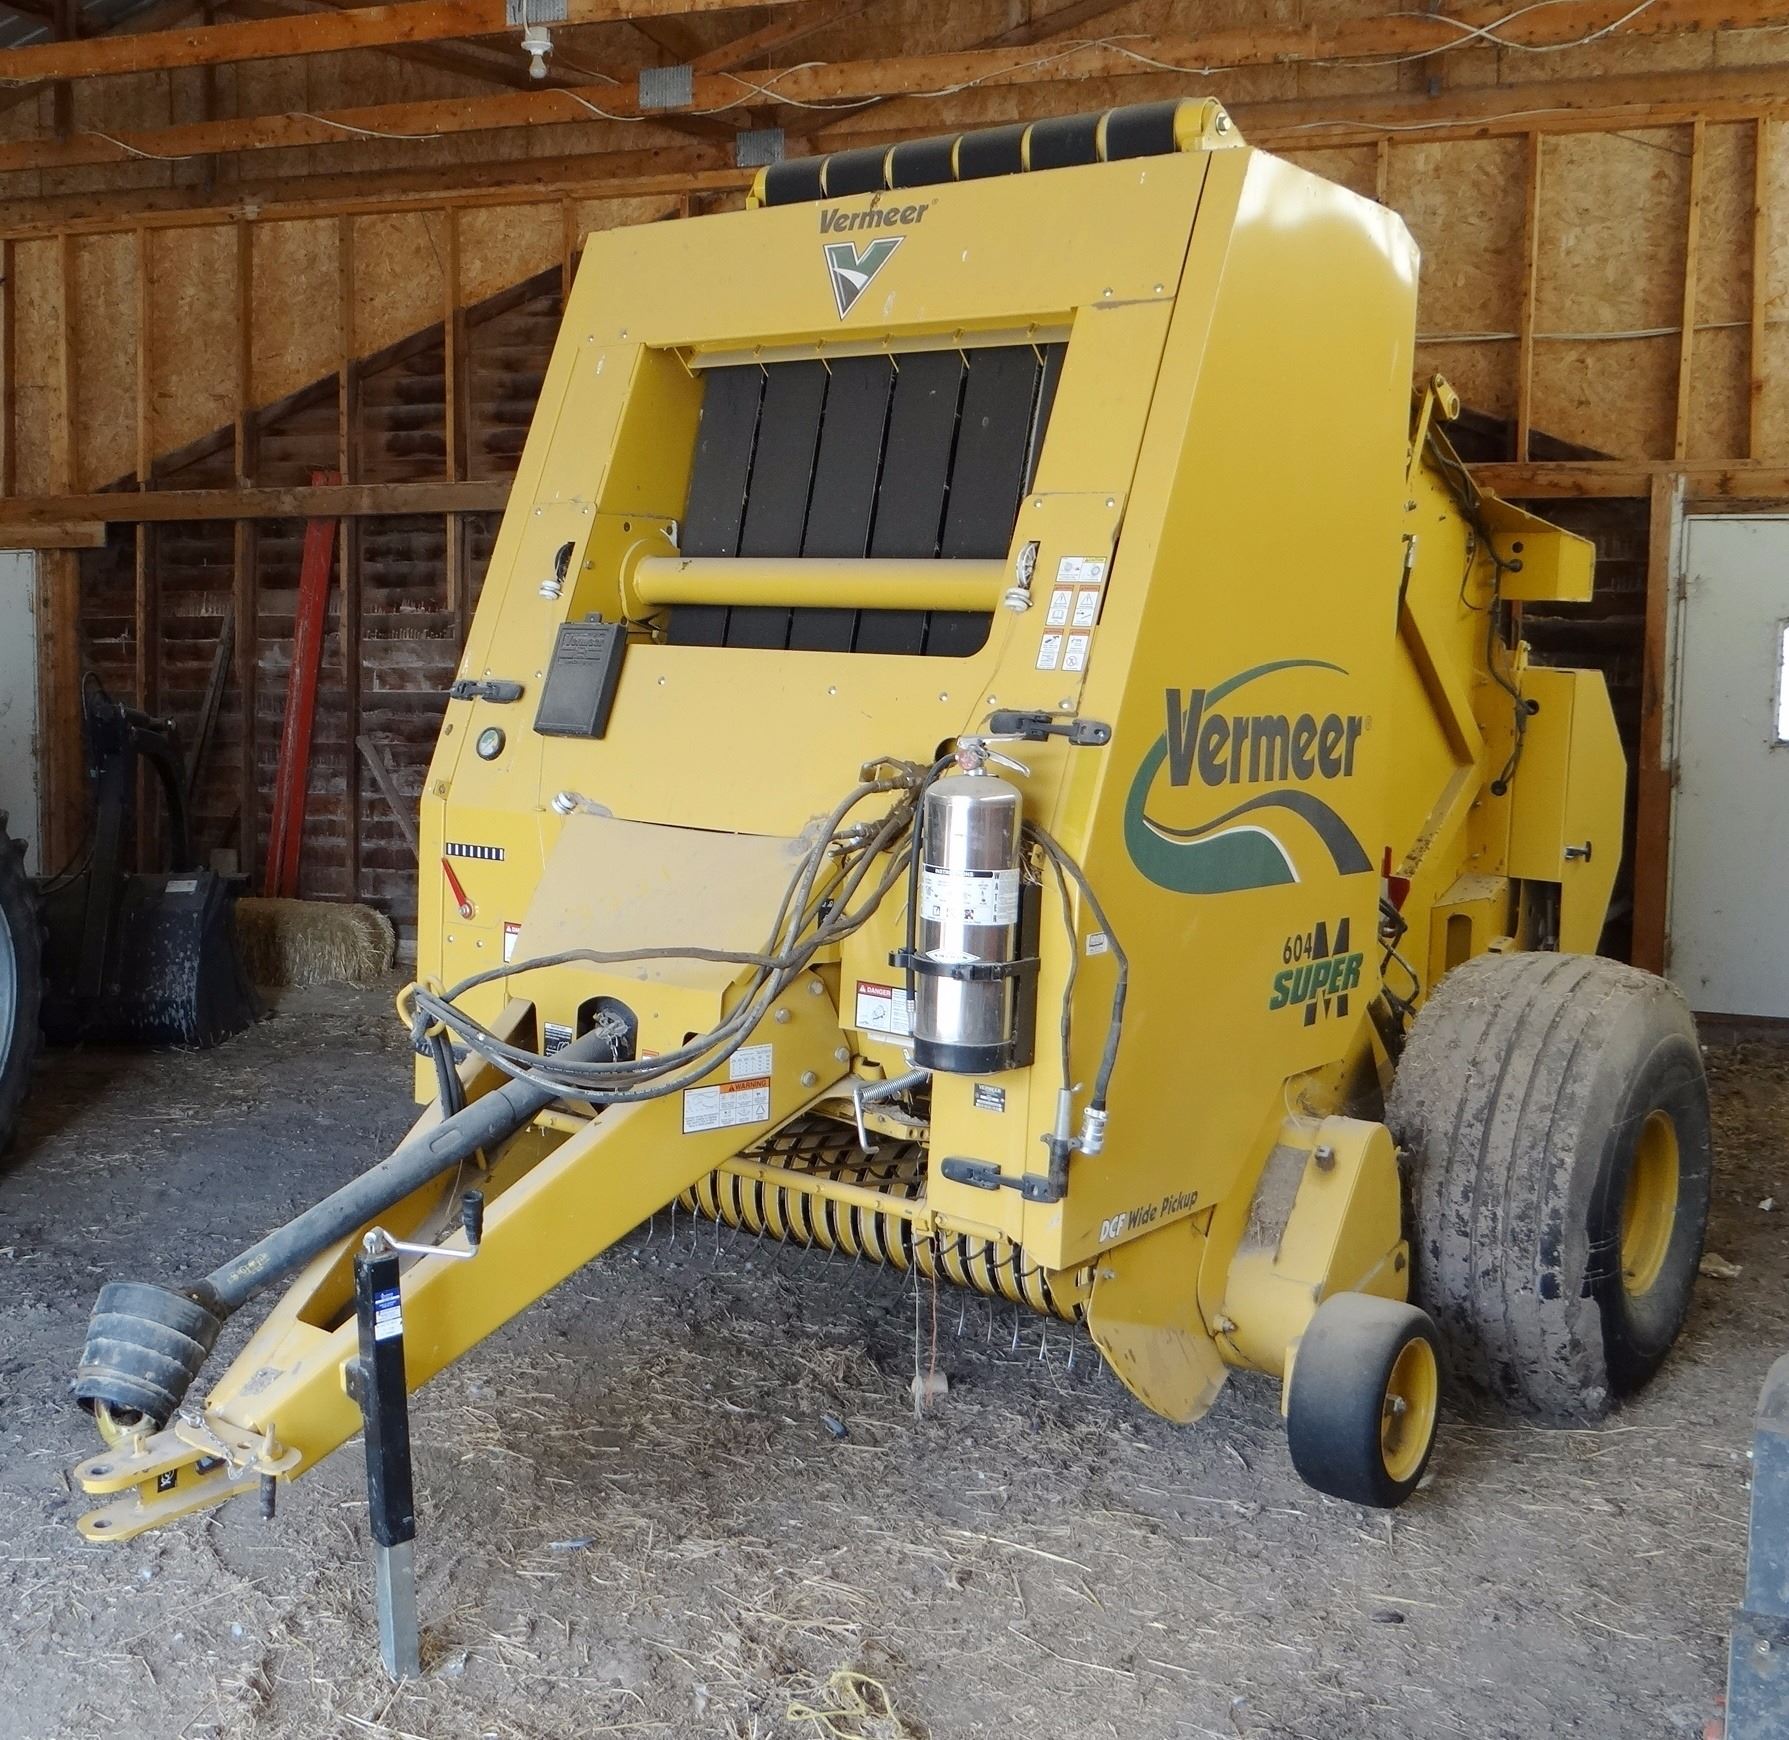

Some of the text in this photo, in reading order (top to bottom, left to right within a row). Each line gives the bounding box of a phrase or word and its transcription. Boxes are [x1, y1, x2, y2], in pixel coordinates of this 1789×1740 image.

[819, 203, 929, 234] Vermeer
[1165, 687, 1363, 787] Vermeer
[1283, 932, 1313, 965] 604
[866, 986, 891, 997] DANGER
[1269, 952, 1364, 1011] SUPER
[735, 1079, 767, 1091] WARNING
[1099, 1190, 1198, 1243] DCF Wide Pickup
